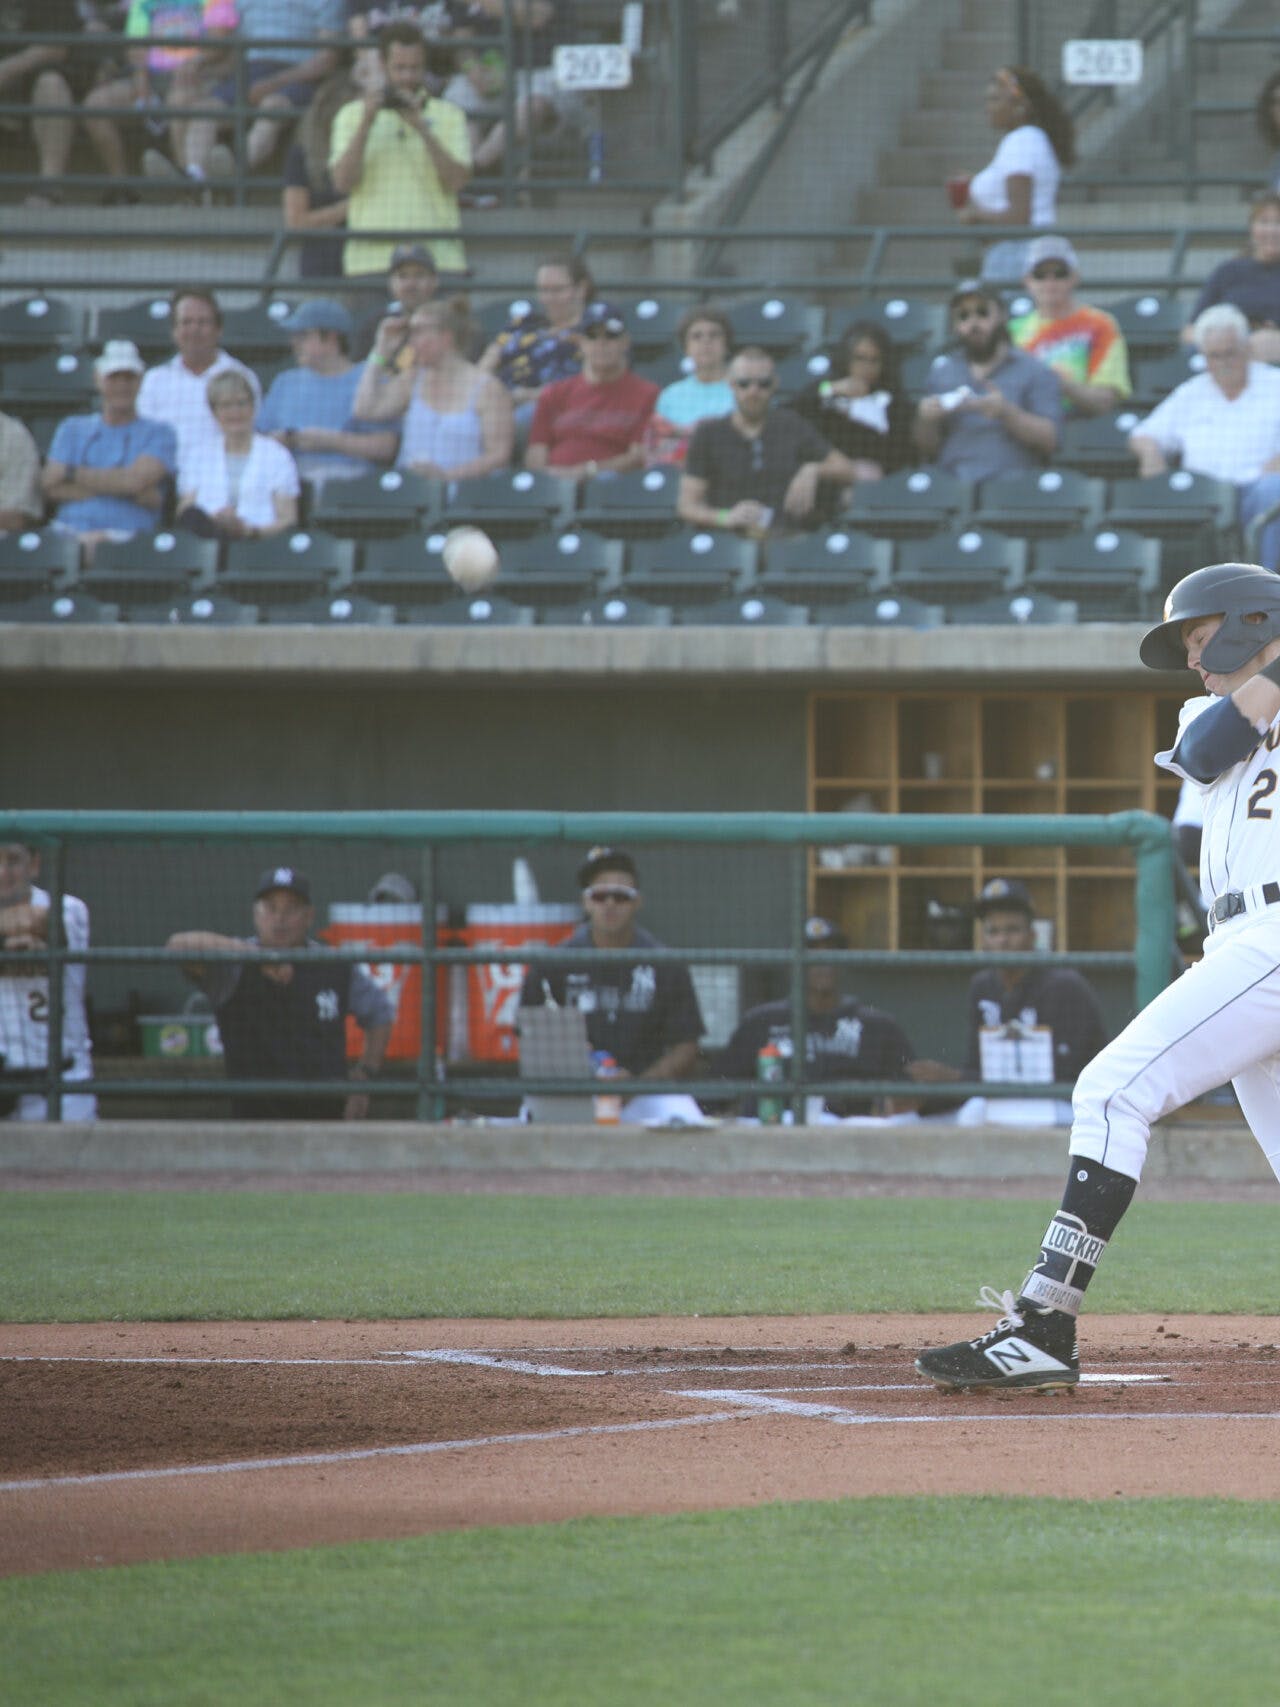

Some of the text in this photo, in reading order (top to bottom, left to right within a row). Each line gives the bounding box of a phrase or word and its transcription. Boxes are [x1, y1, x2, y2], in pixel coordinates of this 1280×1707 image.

[564, 50, 623, 81] 202
[1073, 46, 1133, 76] 203
[1247, 768, 1278, 819] 2
[990, 1341, 1031, 1371] N
